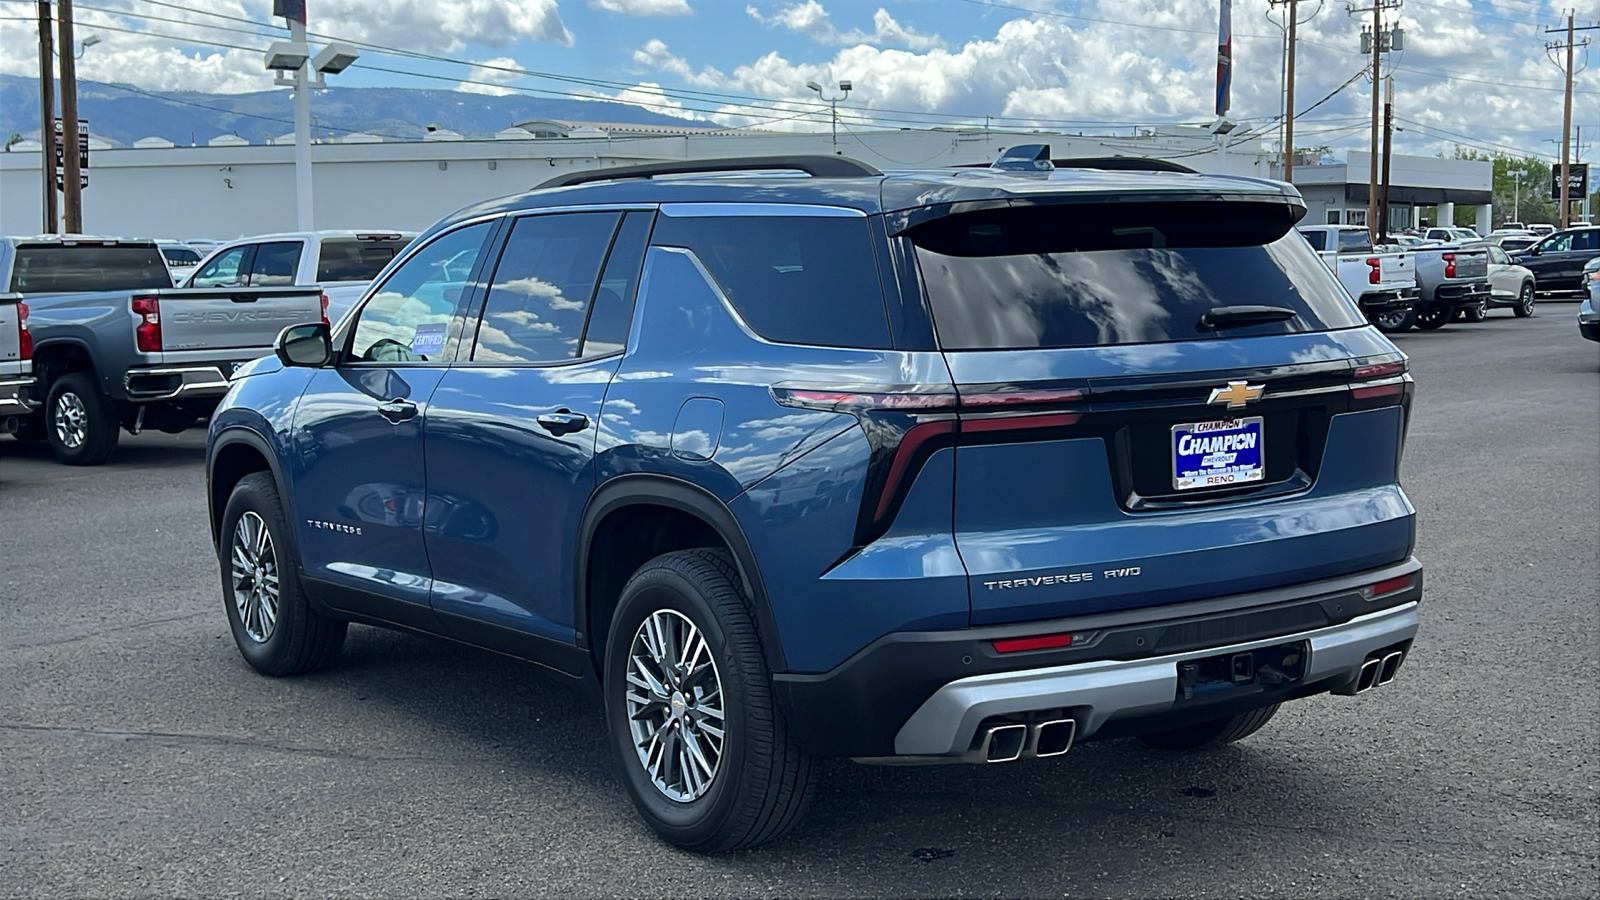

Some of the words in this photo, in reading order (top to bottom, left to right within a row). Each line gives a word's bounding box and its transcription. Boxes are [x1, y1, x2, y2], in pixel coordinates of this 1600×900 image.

[415, 335, 442, 345] CERTIFIED
[1198, 420, 1239, 431] CHAMPION
[1178, 433, 1256, 456] CHAMPION
[1207, 475, 1235, 484] RENO
[307, 520, 362, 535] TRAVERSE
[984, 572, 1093, 590] TRAVERSE
[1104, 567, 1141, 579] AWD
